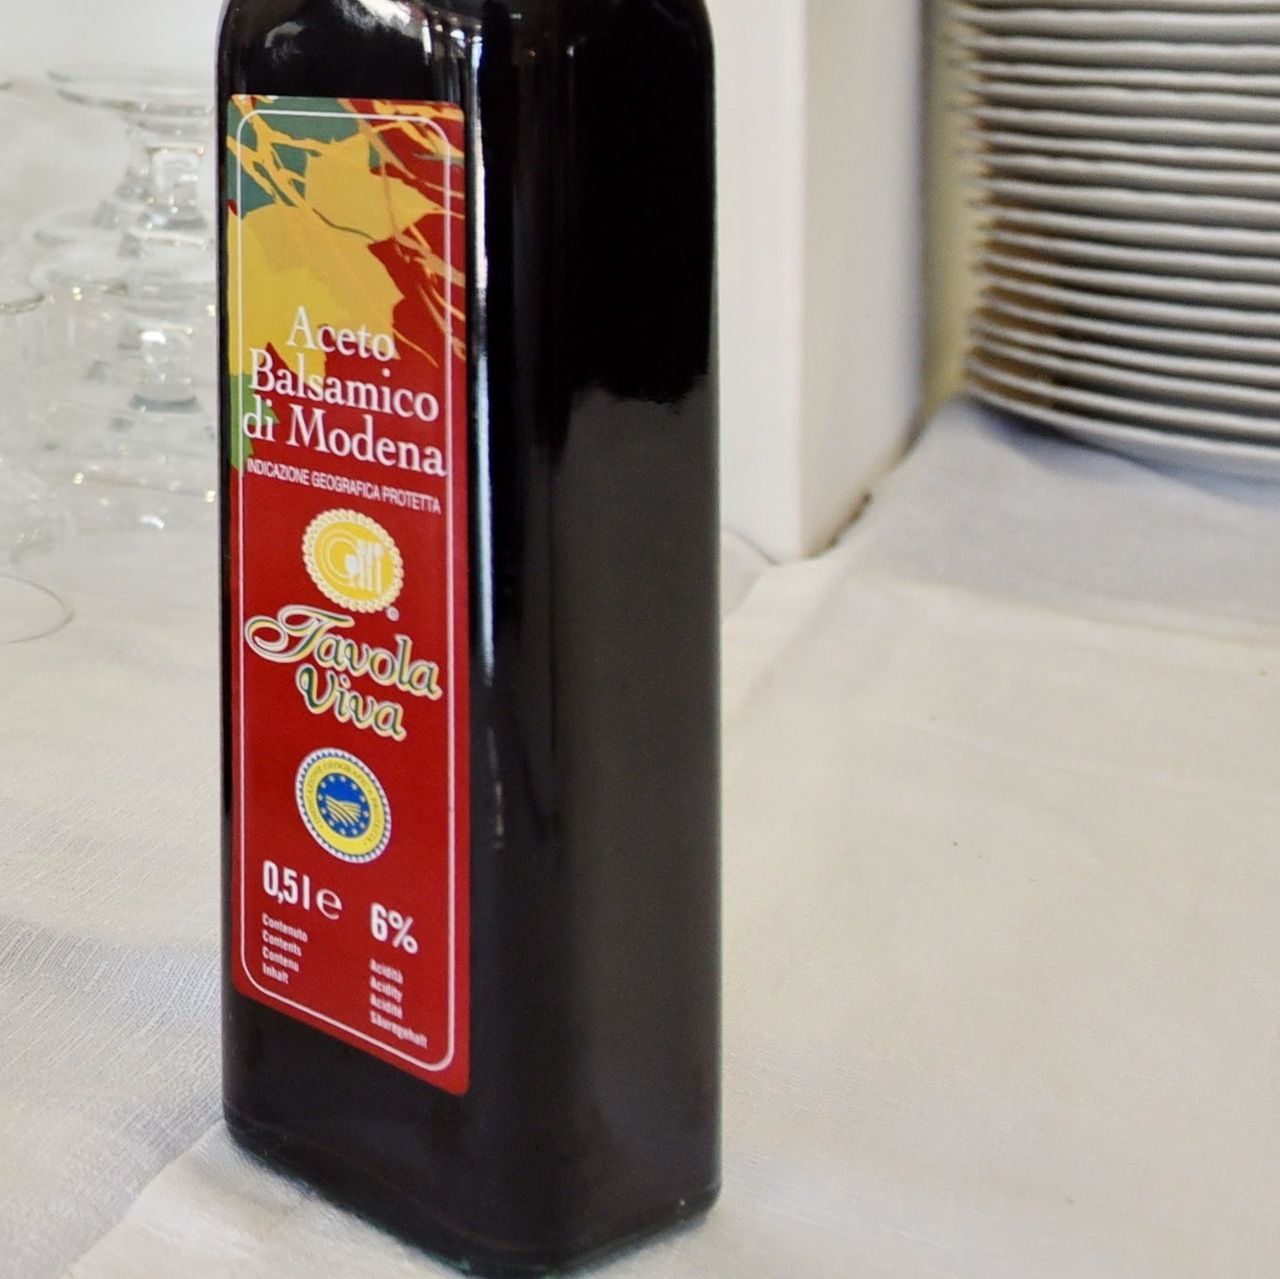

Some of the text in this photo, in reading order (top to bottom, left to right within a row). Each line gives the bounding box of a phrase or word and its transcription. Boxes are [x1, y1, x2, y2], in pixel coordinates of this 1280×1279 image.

[286, 305, 397, 363] Aceto
[249, 347, 439, 422] Balsamico
[243, 395, 448, 478] di Modena
[246, 457, 441, 516] INDICAZIONE GEOGRAFICA PROTETTA
[244, 604, 444, 701] Tavola
[296, 663, 407, 742] Viva
[261, 912, 309, 944] Contenuto
[261, 929, 302, 958] Contents
[370, 901, 419, 955] 6%
[261, 946, 300, 973] Contenu
[262, 962, 290, 985] Inhalt
